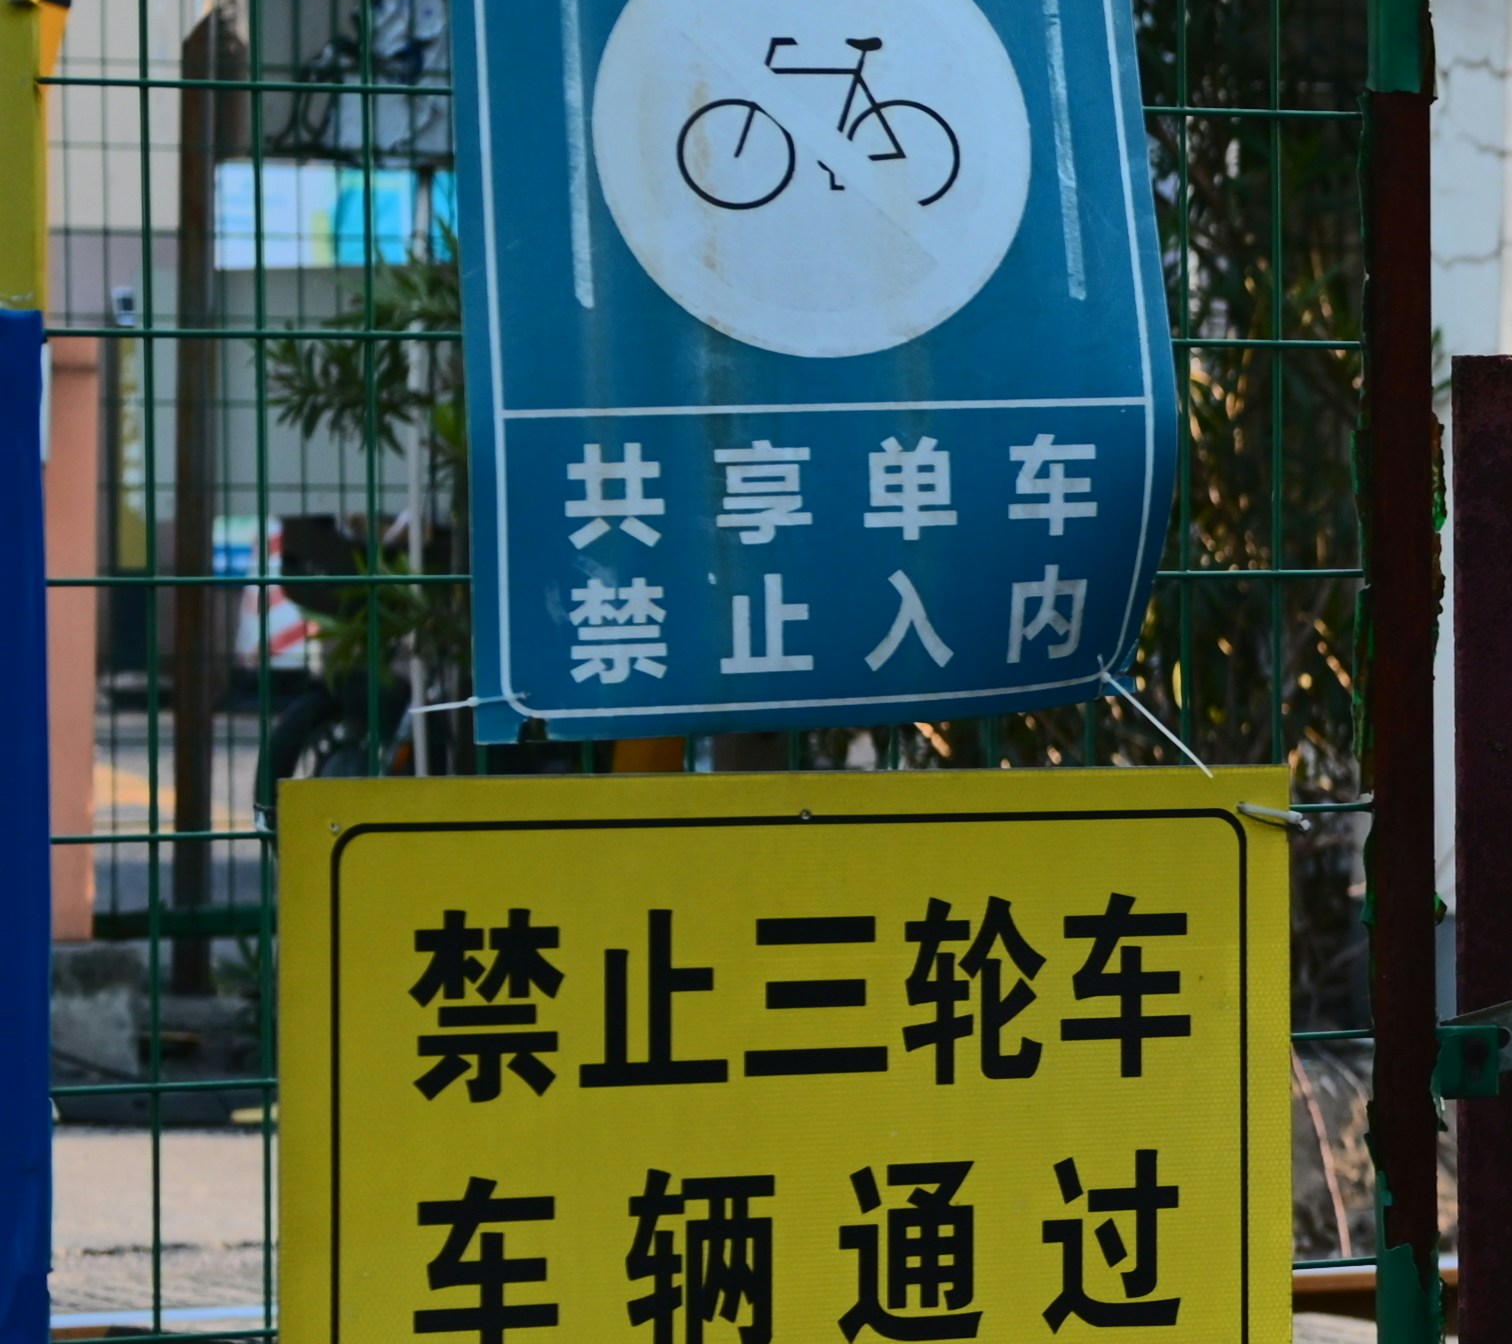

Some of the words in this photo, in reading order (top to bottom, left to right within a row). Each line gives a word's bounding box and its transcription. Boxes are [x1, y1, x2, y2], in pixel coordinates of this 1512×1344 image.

[564, 434, 1099, 548] 共享单车
[568, 567, 1088, 685] 禁止入内
[408, 892, 1191, 1103] 禁止三轮车
